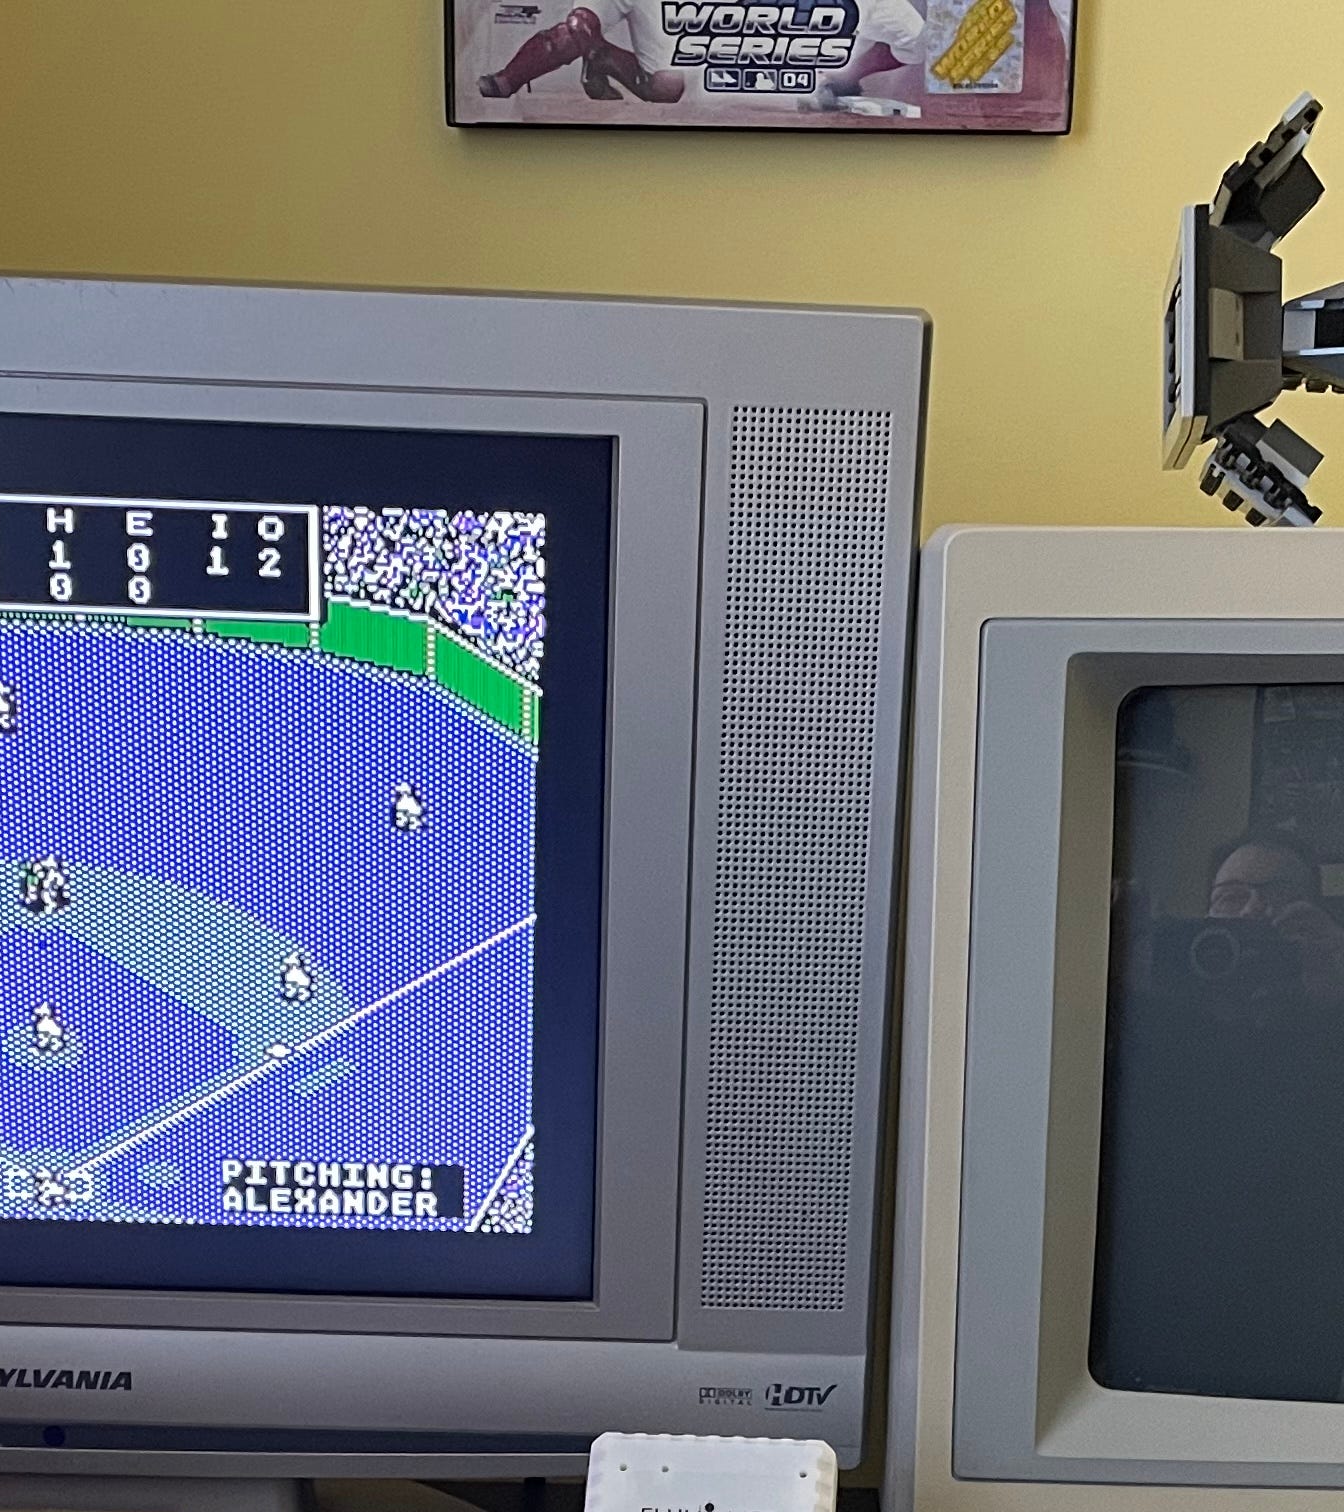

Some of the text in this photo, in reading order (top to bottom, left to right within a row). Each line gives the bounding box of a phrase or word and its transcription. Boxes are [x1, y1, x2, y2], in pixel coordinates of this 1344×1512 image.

[664, 5, 846, 35] WORLD
[674, 36, 852, 65] SERIES
[783, 73, 809, 87] 04
[47, 508, 73, 533] H
[126, 511, 153, 536] E
[212, 513, 229, 540] I
[49, 542, 71, 570] 1
[128, 543, 149, 574] 0
[207, 549, 229, 576] 1
[258, 550, 281, 578] 2
[50, 573, 72, 601] 0
[128, 574, 151, 604] 0
[221, 1159, 432, 1190] PITCHING:
[222, 1186, 438, 1217] ALEXANDER
